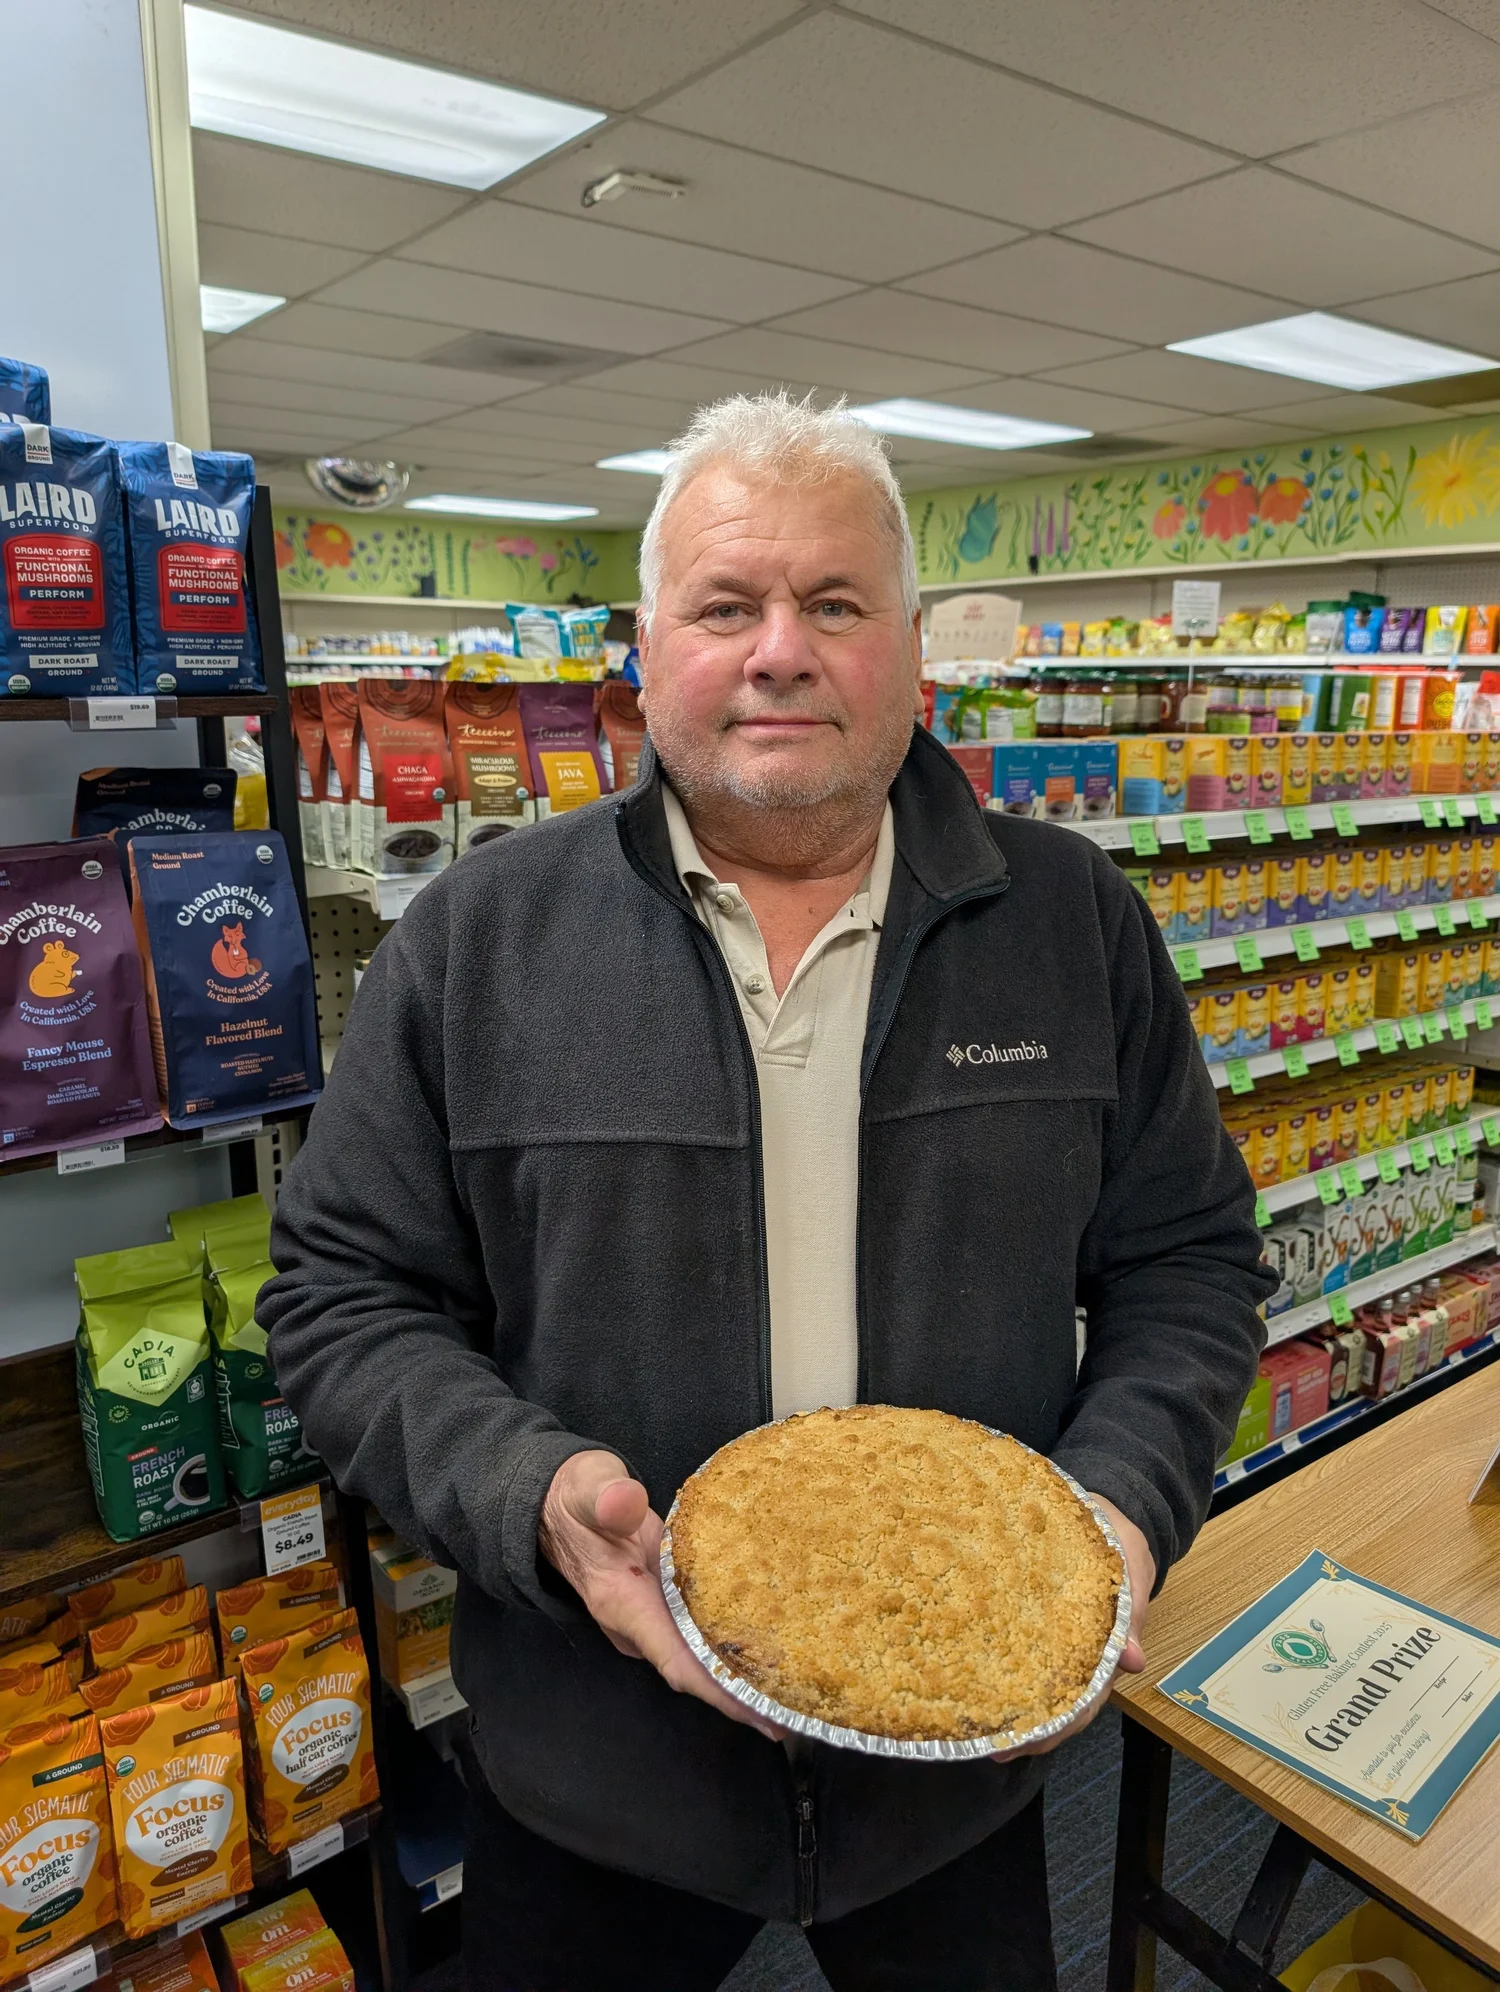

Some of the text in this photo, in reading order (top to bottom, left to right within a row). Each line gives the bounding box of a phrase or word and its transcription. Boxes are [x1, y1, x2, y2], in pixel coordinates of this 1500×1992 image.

[27, 444, 49, 452] DARK
[174, 472, 194, 480] DARK
[0, 482, 97, 525] LAIRD
[154, 499, 240, 537] LAIRD
[14, 546, 91, 557] ORGANIC COFFEE
[168, 554, 237, 565] ORGANIC COFFEE
[16, 562, 93, 573] FUNCTIONAL
[168, 569, 238, 580] FUNCTIONAL
[17, 573, 93, 583] MUSHROOMS
[169, 579, 239, 590] MUSHROOMS
[30, 590, 84, 598] PERFORM
[179, 594, 230, 604] PERFORM
[397, 765, 428, 775] CHAGA
[470, 757, 514, 765] MIRACULOUS
[557, 768, 584, 780] JAVA
[152, 851, 205, 861] Medium Roast
[153, 862, 181, 870] Ground
[176, 882, 275, 927] Chamberlain
[202, 899, 254, 924] Coffee
[0, 902, 102, 945] Chamberlain
[17, 917, 77, 944] Coffee
[206, 971, 270, 994] Created with Love
[20, 989, 95, 1016] Created with Love
[207, 983, 274, 1004] In California, USA
[20, 1001, 97, 1026] In California, USA
[221, 1018, 268, 1032] Hazelnut
[206, 1025, 283, 1046] Flavored Blend
[27, 1038, 104, 1059] Fancy Mouse
[966, 1040, 1049, 1064] Columbia
[23, 1048, 113, 1072] Espresso Blend
[221, 1060, 245, 1069] ROASTED
[47, 1086, 100, 1100] DARK CHOCOLATE
[58, 1084, 87, 1092] CARAMEL
[47, 1092, 101, 1106] ROASTED PEANUTS
[124, 1340, 175, 1369] CADIA
[141, 1416, 180, 1431] ORGANIC
[264, 1405, 293, 1423] FRE
[265, 1416, 300, 1436] ROAS
[131, 1448, 155, 1460] GROUND
[132, 1446, 185, 1476] FRENCH
[133, 1462, 177, 1489] ROAST
[265, 1493, 318, 1516] everyday
[140, 1524, 152, 1533] NET
[152, 1521, 162, 1530] WT
[163, 1517, 170, 1525] 10
[171, 1514, 180, 1522] OZ
[267, 1522, 287, 1533] Organic
[287, 1517, 305, 1528] French
[282, 1512, 302, 1522] CADIA
[276, 1521, 311, 1536] Ground Coffee
[275, 1532, 314, 1555] $8.49
[413, 1580, 446, 1597] ORGANIC
[419, 1588, 441, 1599] INDIA
[1287, 1622, 1393, 1721] Gluten Free Baking Contest 2025
[166, 1681, 195, 1693] GROUND
[1304, 1626, 1442, 1753] Grand Prize
[1461, 1690, 1474, 1703] Baker
[265, 1672, 356, 1729] FOUR SIGMATIC
[191, 1724, 221, 1737] GROUND
[281, 1711, 353, 1756] Focus
[286, 1731, 358, 1775] half caf coffee
[299, 1729, 342, 1757] organic
[1360, 1713, 1422, 1781] Awarded to you for excellence
[1385, 1728, 1432, 1780] in gluten-less baking!
[52, 1763, 83, 1778] GROUND
[122, 1753, 230, 1804] FOUR SIGMATIC
[0, 1791, 93, 1850] OUR SIGMATIC
[133, 1793, 225, 1838] Focus
[156, 1814, 208, 1840] organic
[164, 1826, 205, 1848] coffee
[0, 1829, 91, 1887] Focus
[164, 1855, 209, 1875] Mental Clarity
[22, 1853, 74, 1887] organic
[30, 1866, 71, 1893] coffee
[176, 1866, 199, 1878] Energy
[30, 1894, 77, 1921] Mental Clarity
